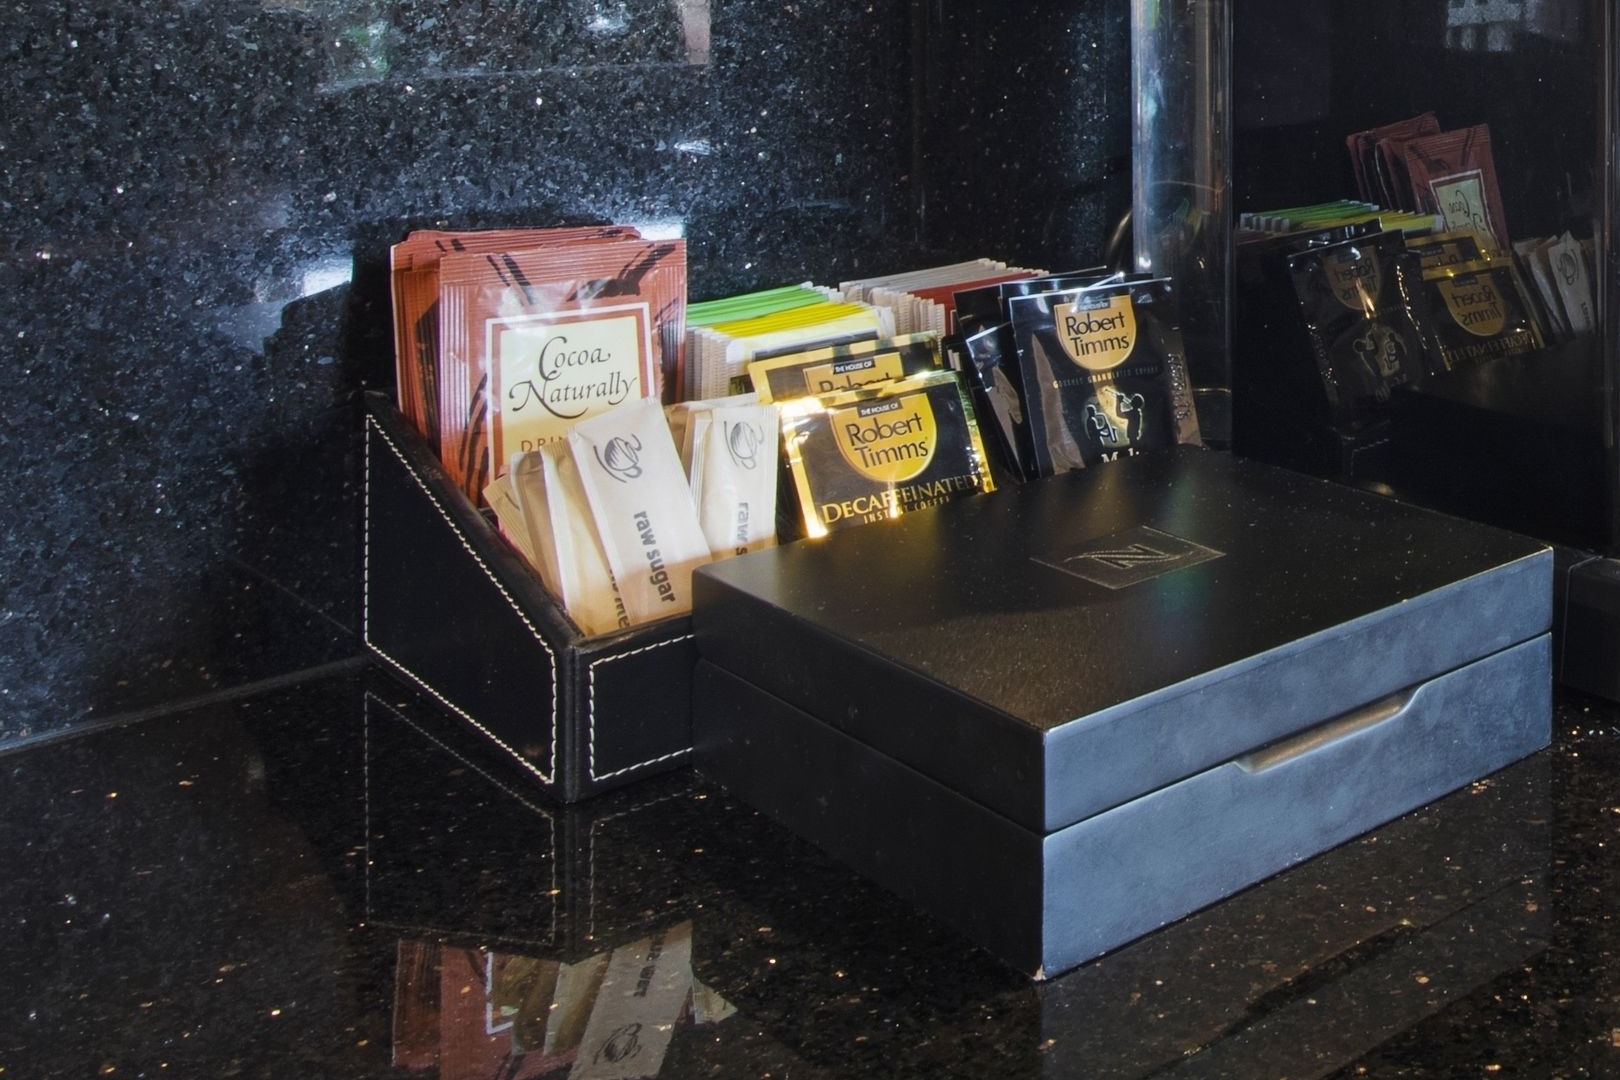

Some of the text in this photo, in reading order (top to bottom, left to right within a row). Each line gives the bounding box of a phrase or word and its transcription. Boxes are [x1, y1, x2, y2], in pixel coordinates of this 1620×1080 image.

[1065, 312, 1125, 337] Robert
[538, 335, 612, 381] Cocoa
[1070, 336, 1130, 357] Timms
[509, 370, 638, 420] Naturally
[845, 412, 923, 447] Robert
[854, 440, 929, 469] Timms
[736, 501, 750, 544] raw
[863, 506, 908, 525] INSTNT
[633, 510, 677, 603] raw sugar
